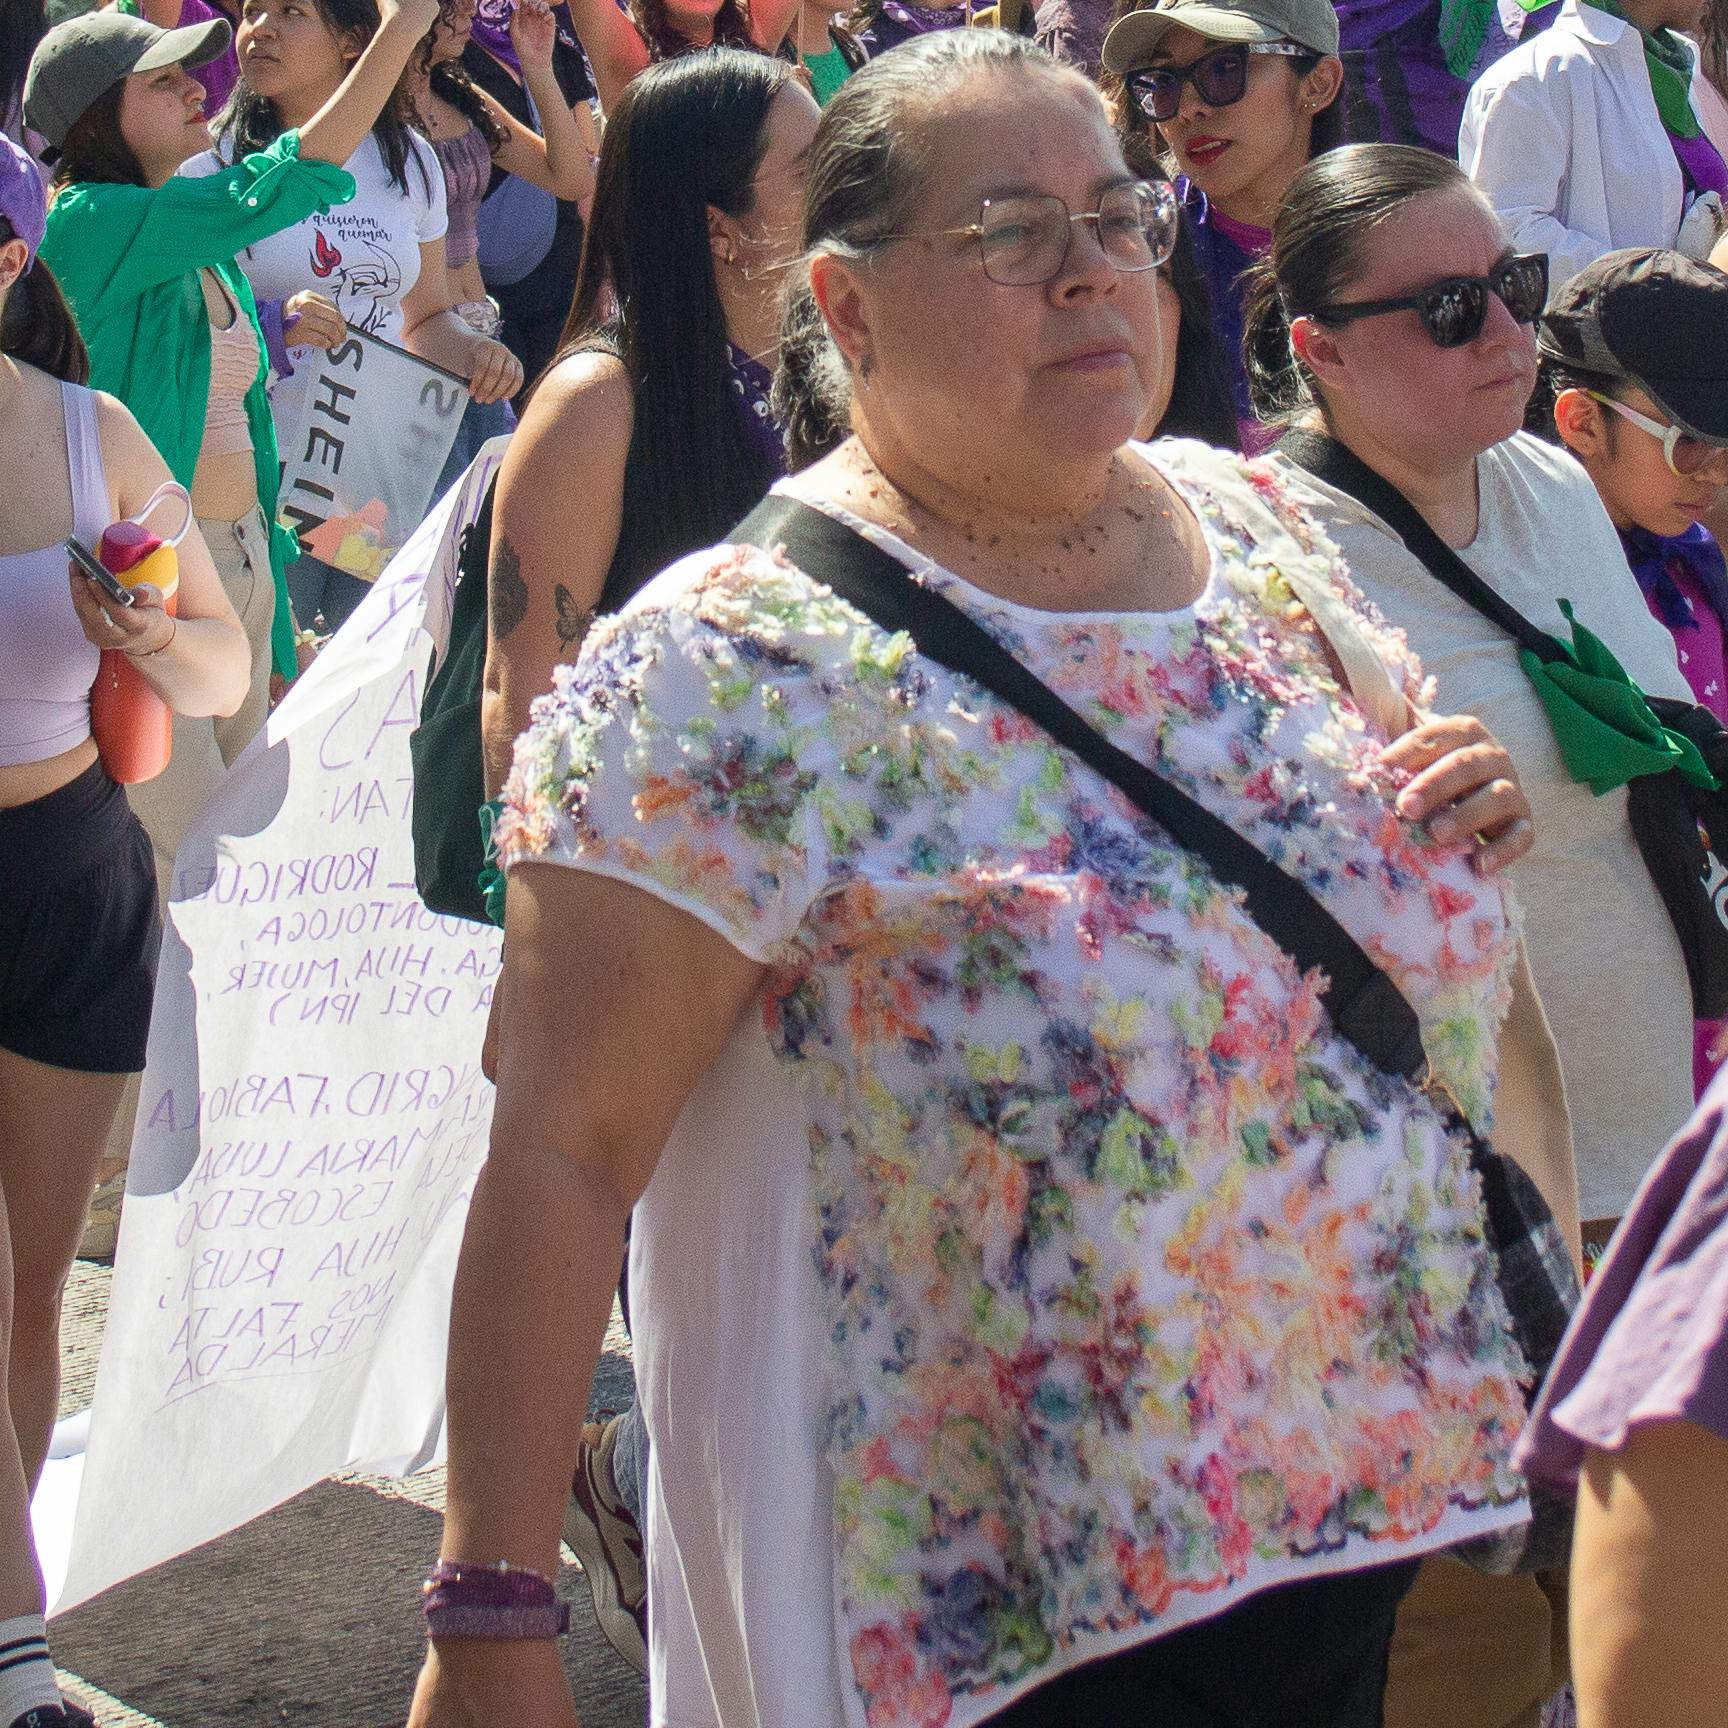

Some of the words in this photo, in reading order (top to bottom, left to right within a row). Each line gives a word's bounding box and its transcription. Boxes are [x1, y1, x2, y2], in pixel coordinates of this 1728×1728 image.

[313, 214, 379, 230] quisieron
[337, 229, 393, 242] quemar
[283, 336, 365, 553] SHEIN
